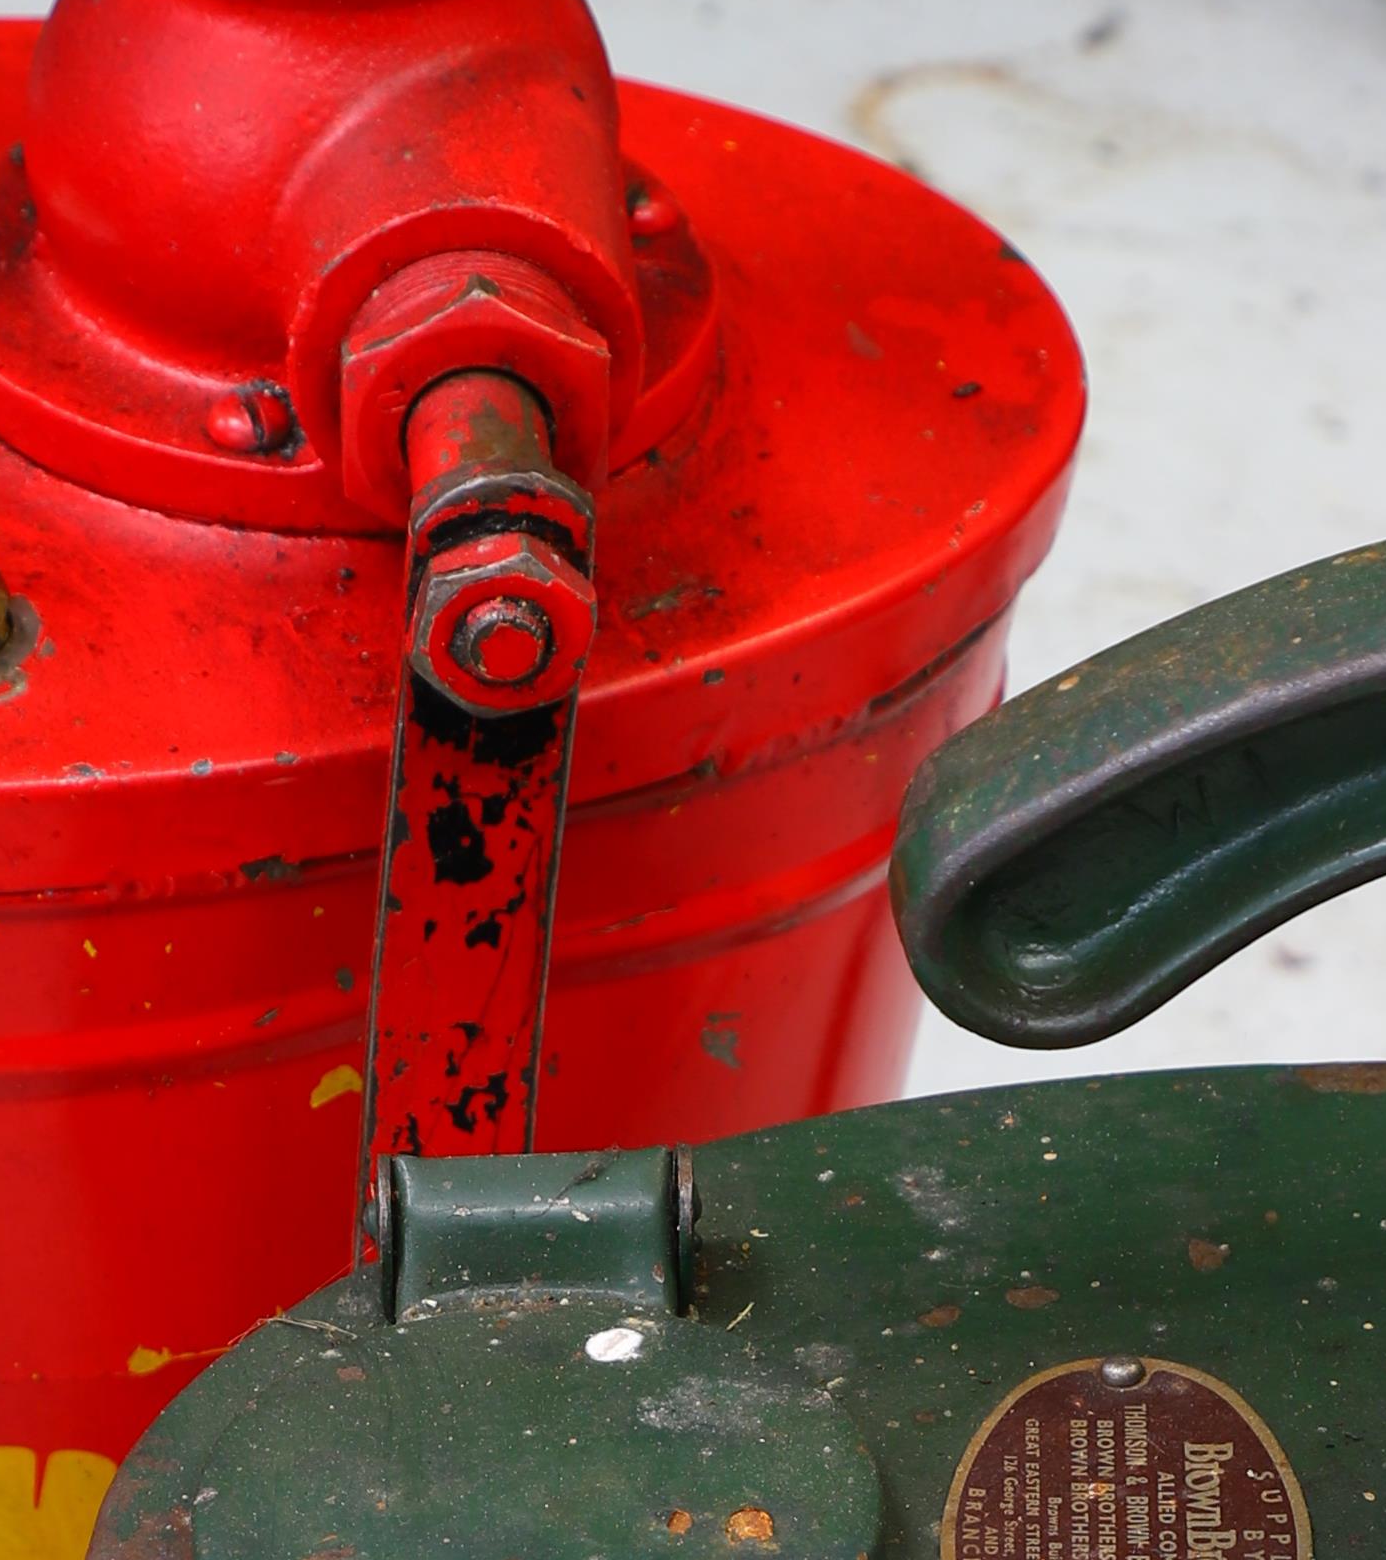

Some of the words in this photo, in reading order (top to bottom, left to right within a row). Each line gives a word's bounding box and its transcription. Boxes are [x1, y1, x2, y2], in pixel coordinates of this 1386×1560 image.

[1025, 1418, 1040, 1457] GREAT
[1070, 1419, 1088, 1476] BROWN
[1096, 1420, 1115, 1477] BROWN
[1124, 1403, 1148, 1465] THOMSON
[1000, 1477, 1018, 1515] George
[1025, 1462, 1040, 1516] EASTERN
[1125, 1476, 1149, 1486] &
[1157, 1471, 1175, 1523] ALLIED
[984, 1526, 999, 1555] AND
[1002, 1520, 1019, 1557] Street,
[1047, 1497, 1062, 1536] Browns
[1071, 1482, 1090, 1560] BROTHERS
[1097, 1482, 1116, 1560] BROTHERS
[1126, 1496, 1150, 1544] BROWN
[1243, 1530, 1265, 1560] BY
